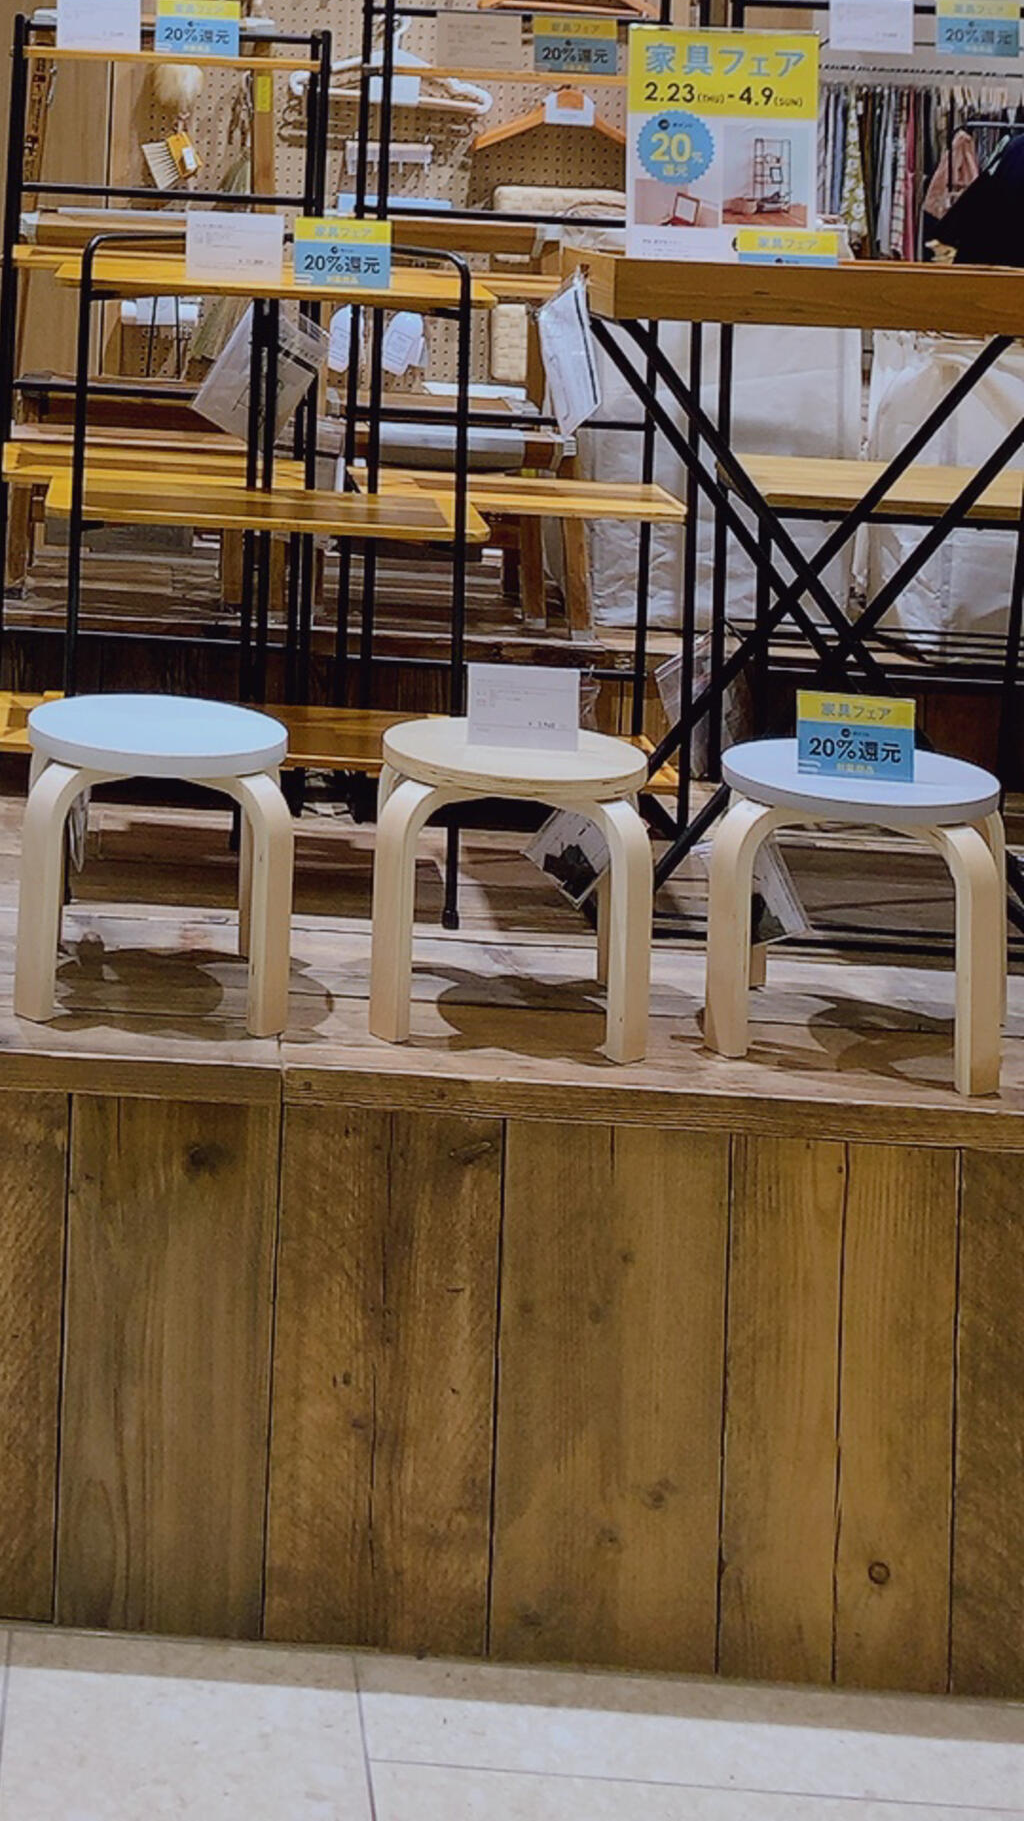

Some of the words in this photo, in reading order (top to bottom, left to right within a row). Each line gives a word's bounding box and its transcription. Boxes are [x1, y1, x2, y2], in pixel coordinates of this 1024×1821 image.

[164, 26, 231, 45] 20%還元
[645, 42, 805, 78] 家具フェア
[304, 253, 380, 275] 20%還元
[821, 702, 892, 721] 家具フェア
[808, 737, 902, 764] 20%還元
